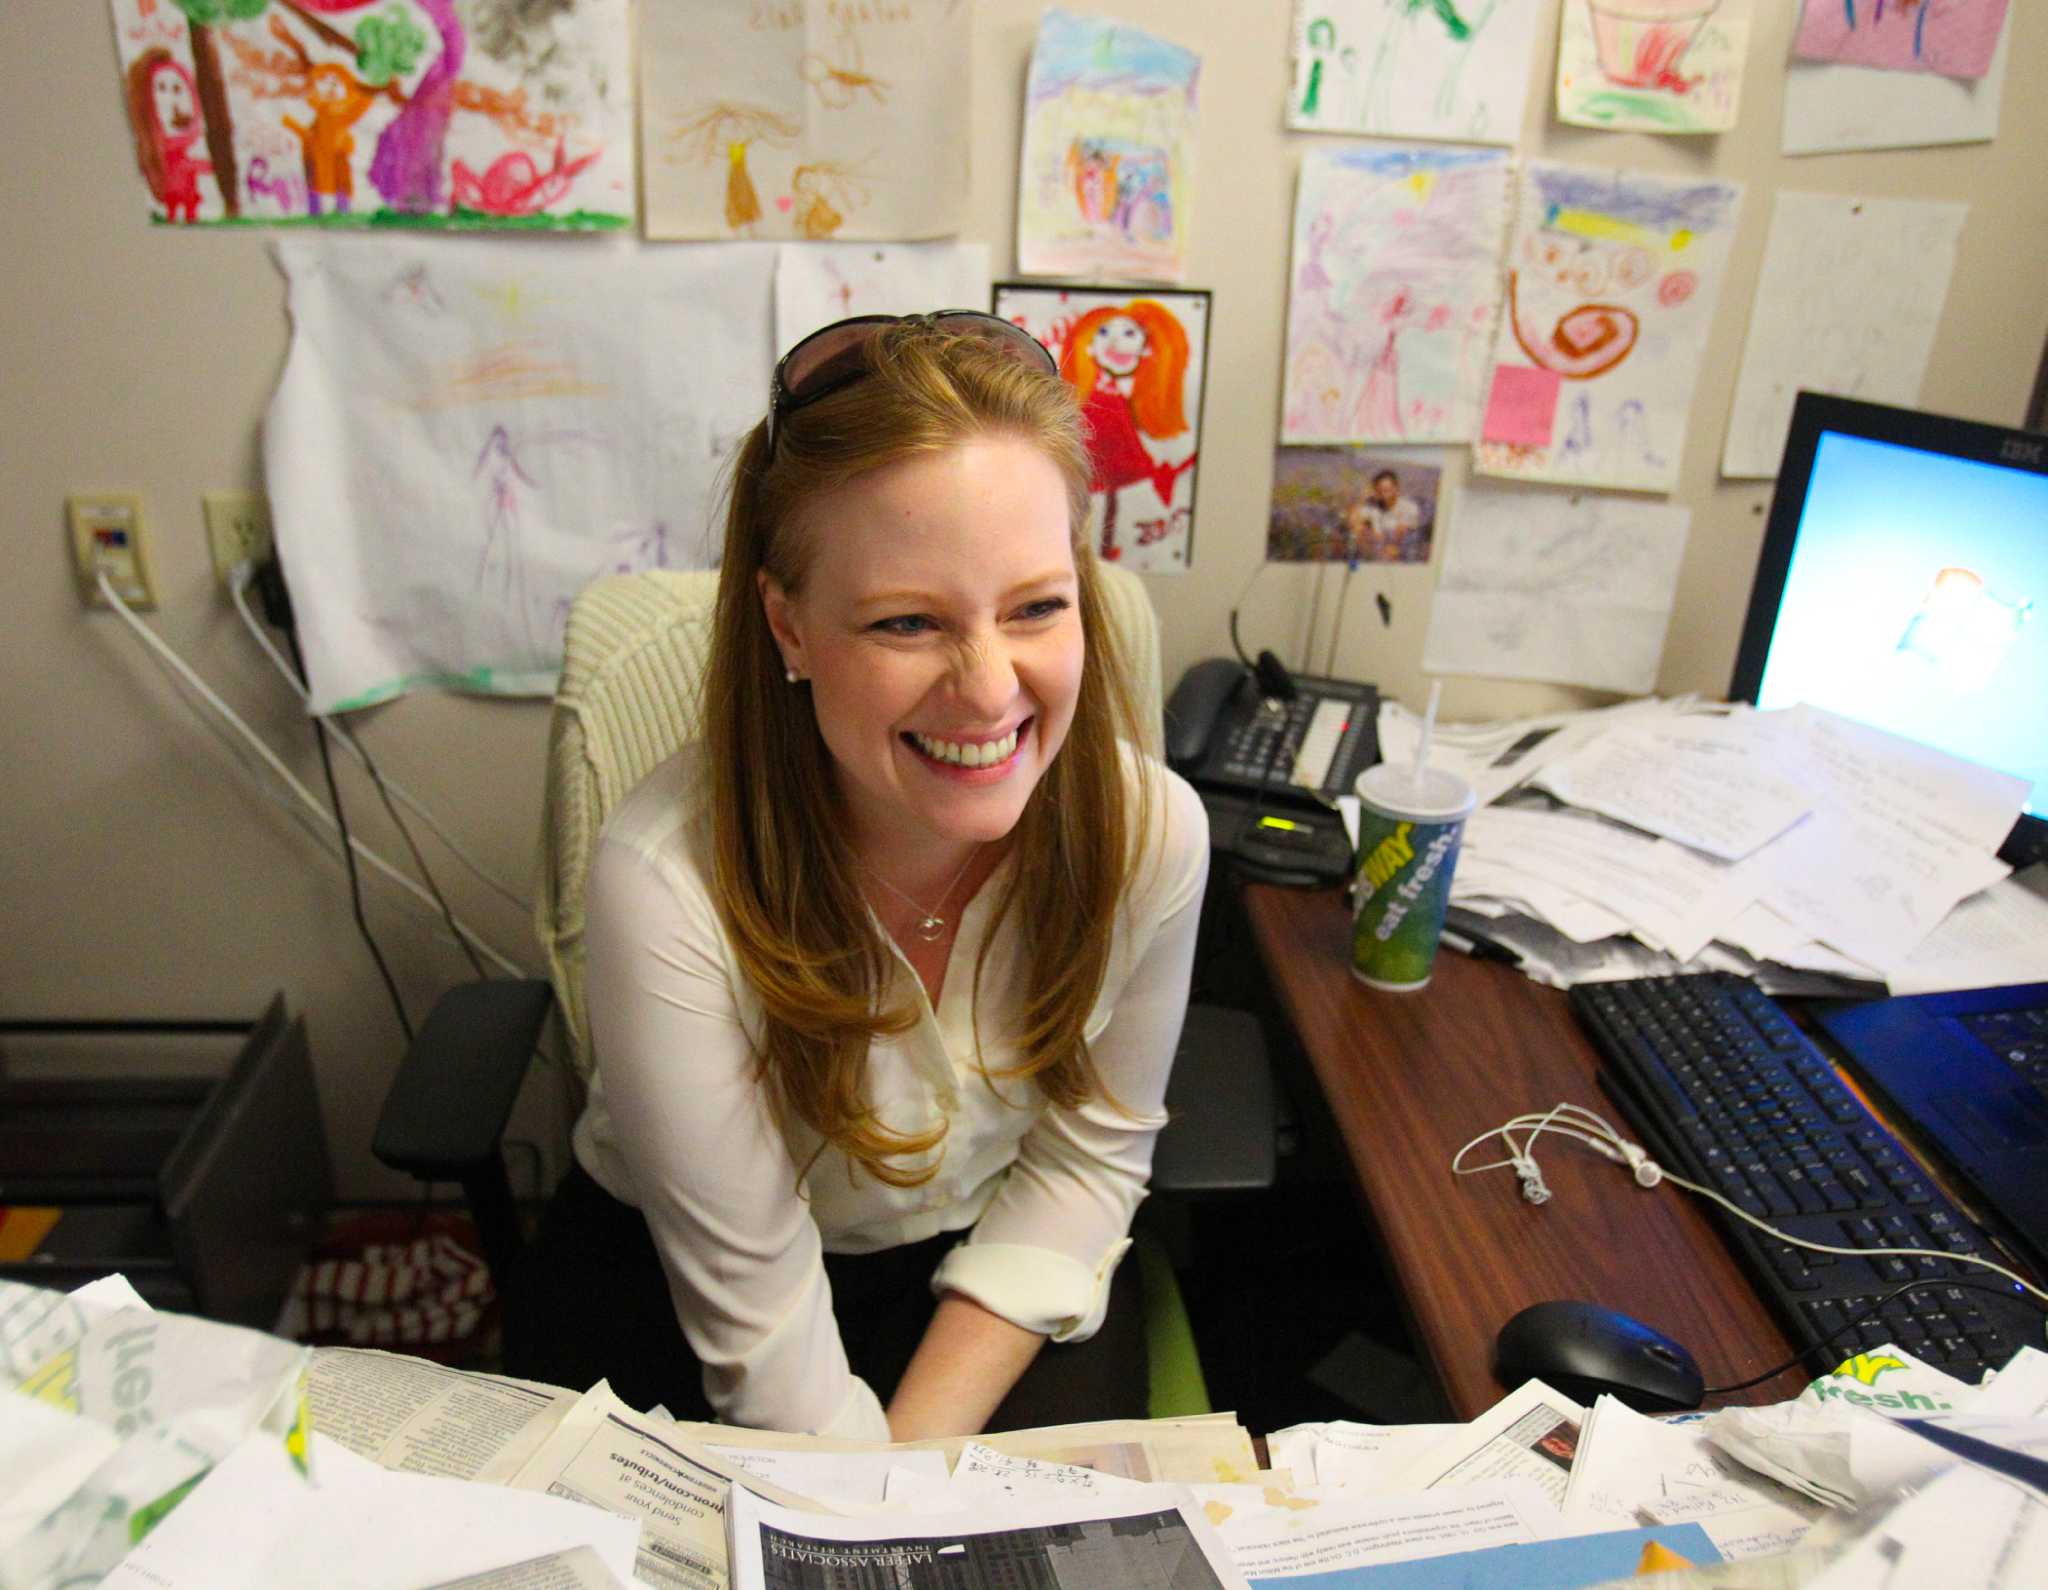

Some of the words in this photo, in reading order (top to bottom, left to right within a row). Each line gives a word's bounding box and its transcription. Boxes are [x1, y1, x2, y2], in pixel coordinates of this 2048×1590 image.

[1376, 900, 1408, 941] eat
[610, 1452, 725, 1515] hron.com/tributes
[634, 1479, 704, 1519] condolences
[625, 1493, 651, 1510] your
[651, 1506, 681, 1526] Send
[771, 1543, 868, 1567] ASSOCIATES
